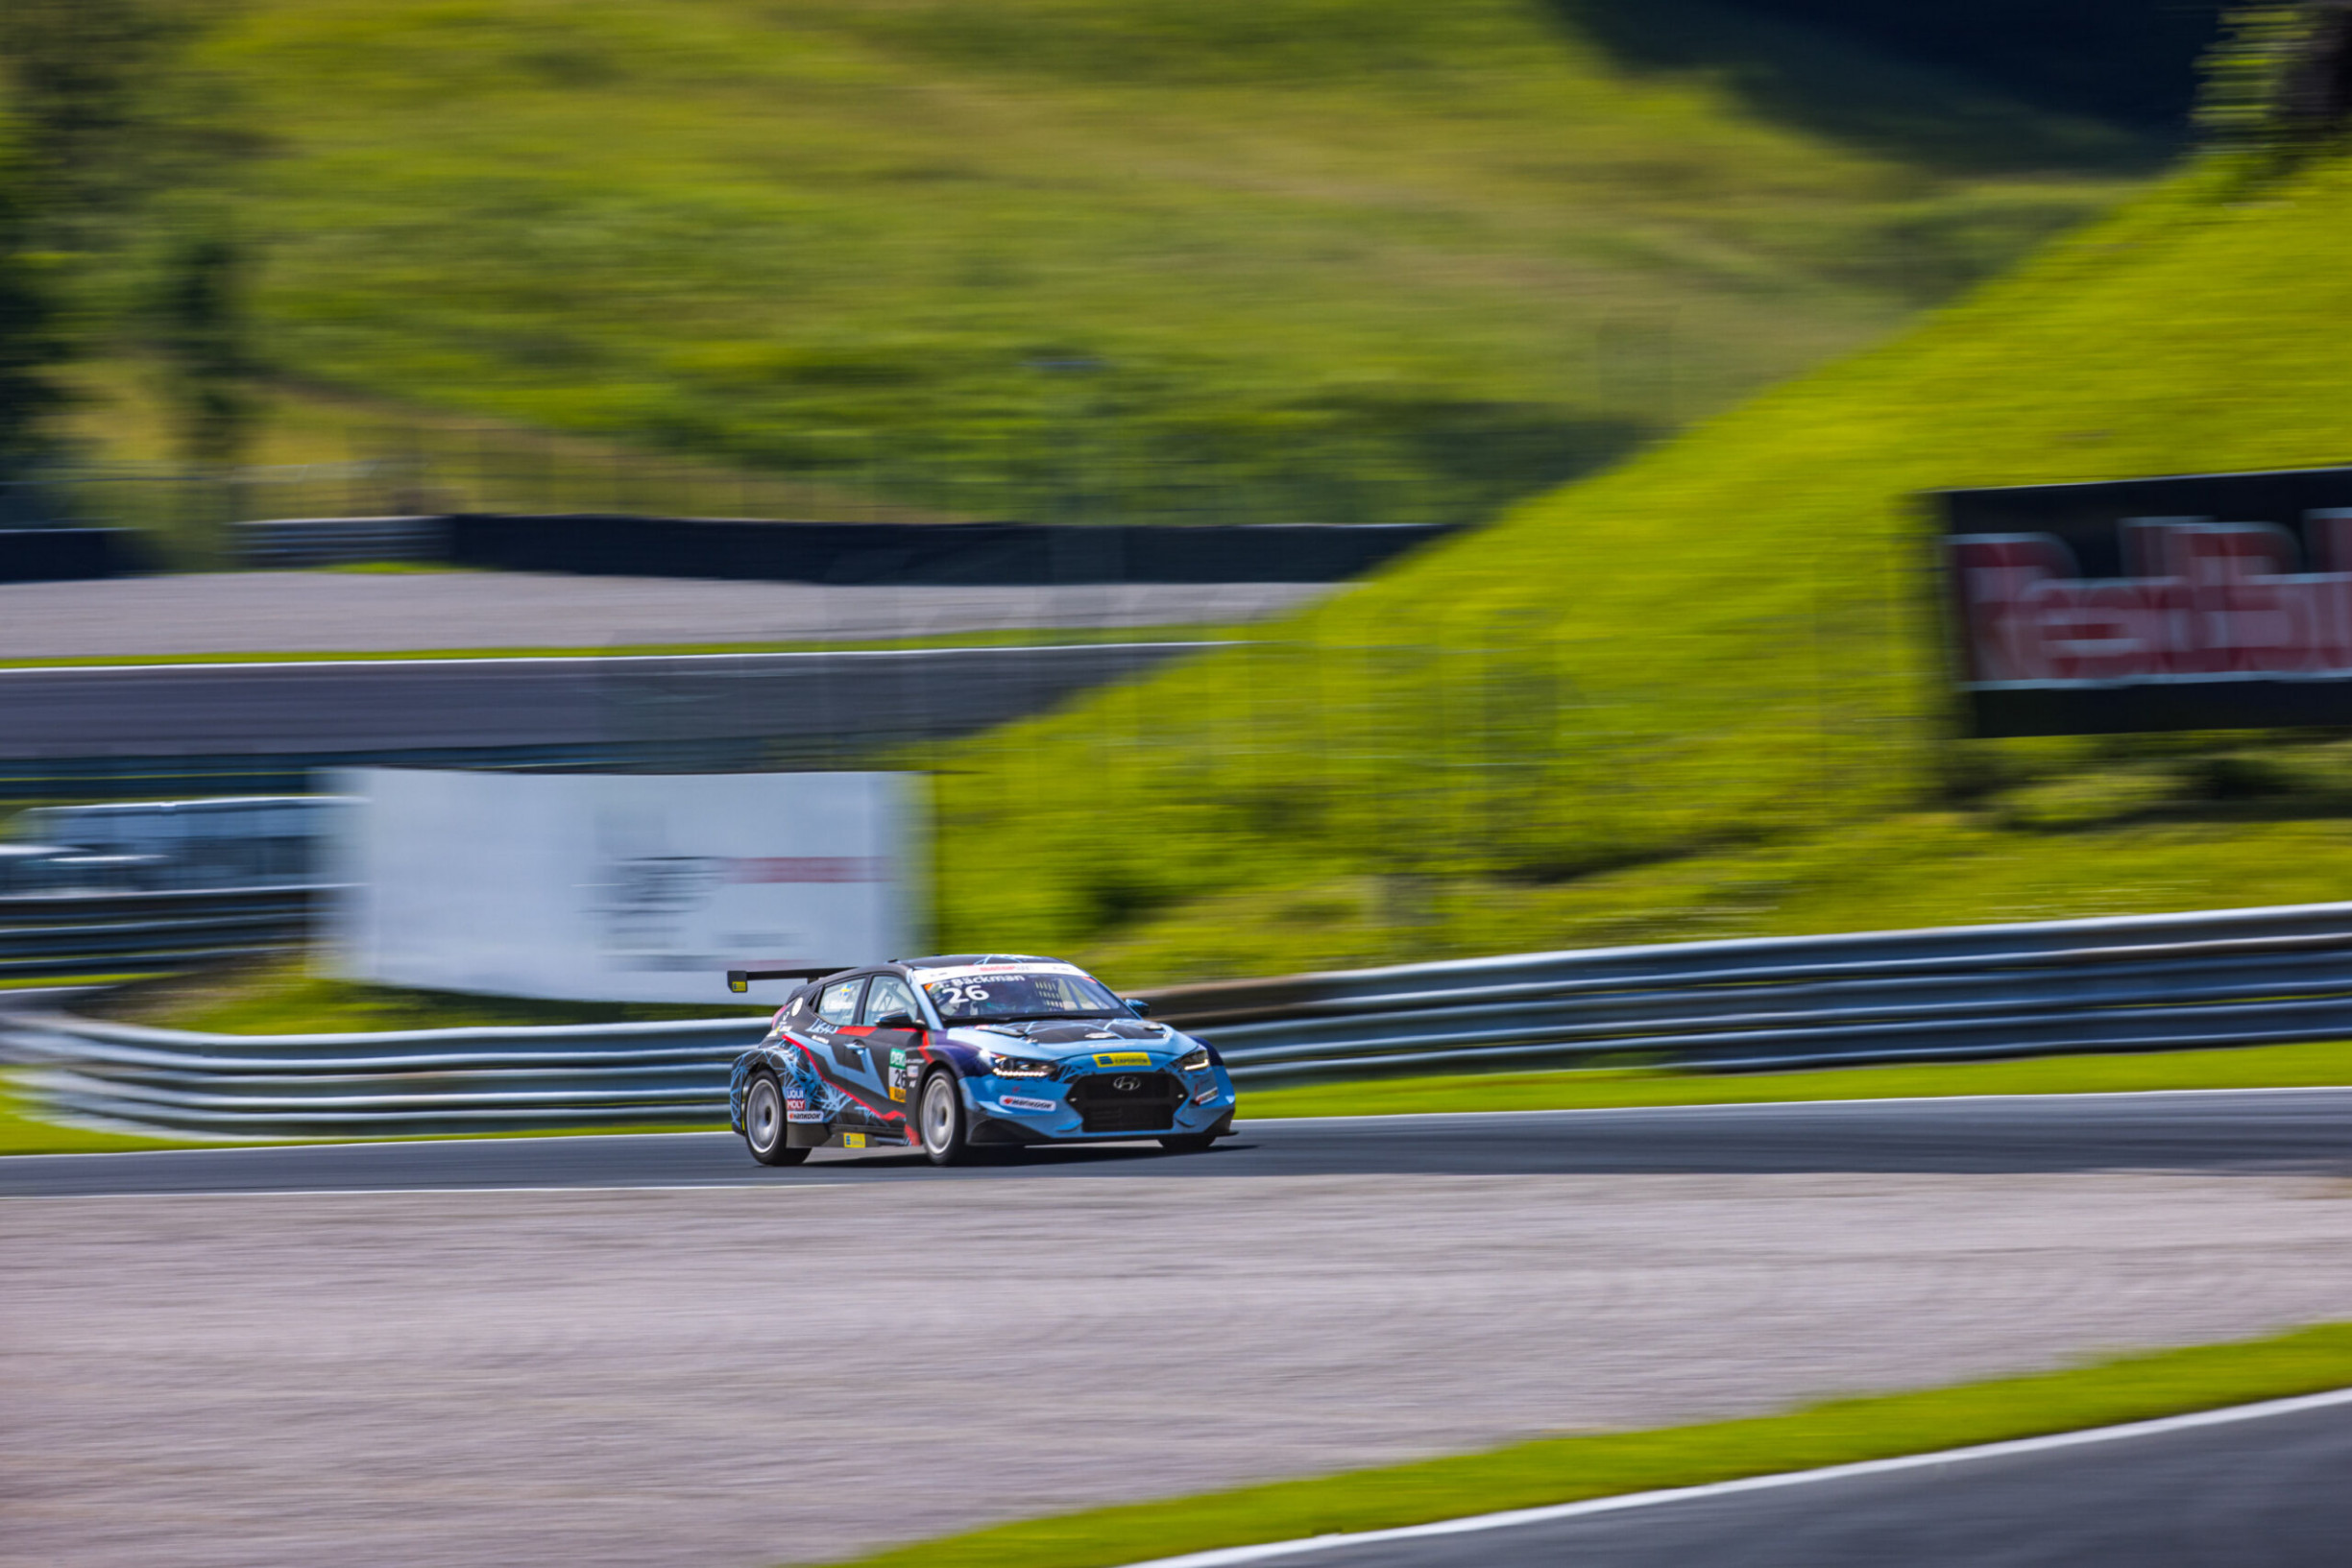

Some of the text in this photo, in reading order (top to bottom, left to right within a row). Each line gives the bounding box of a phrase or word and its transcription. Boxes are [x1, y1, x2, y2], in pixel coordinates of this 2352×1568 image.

[951, 975, 1025, 987] Bäckman
[942, 985, 989, 1004] 26
[894, 1069, 907, 1088] 26
[787, 1089, 804, 1098] LIQUI
[787, 1100, 805, 1109] MOLY
